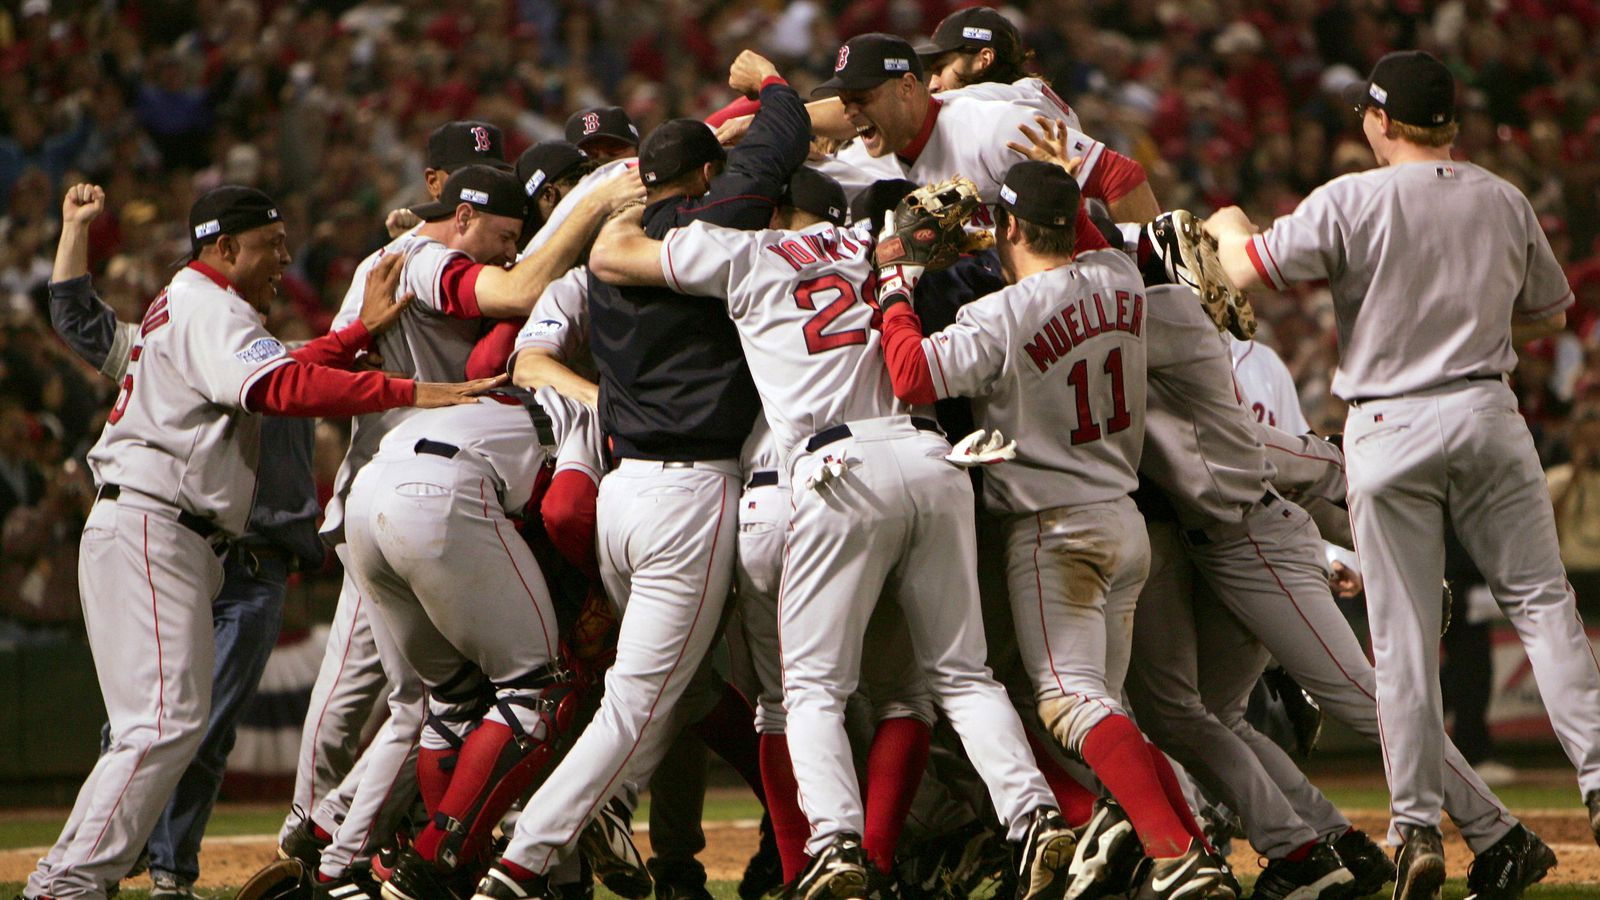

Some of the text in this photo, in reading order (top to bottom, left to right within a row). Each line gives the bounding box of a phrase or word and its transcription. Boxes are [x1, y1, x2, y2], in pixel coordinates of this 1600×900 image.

[471, 127, 491, 152] B
[583, 112, 600, 135] B
[1024, 290, 1144, 374] MUELLER
[1067, 346, 1131, 446] 11
